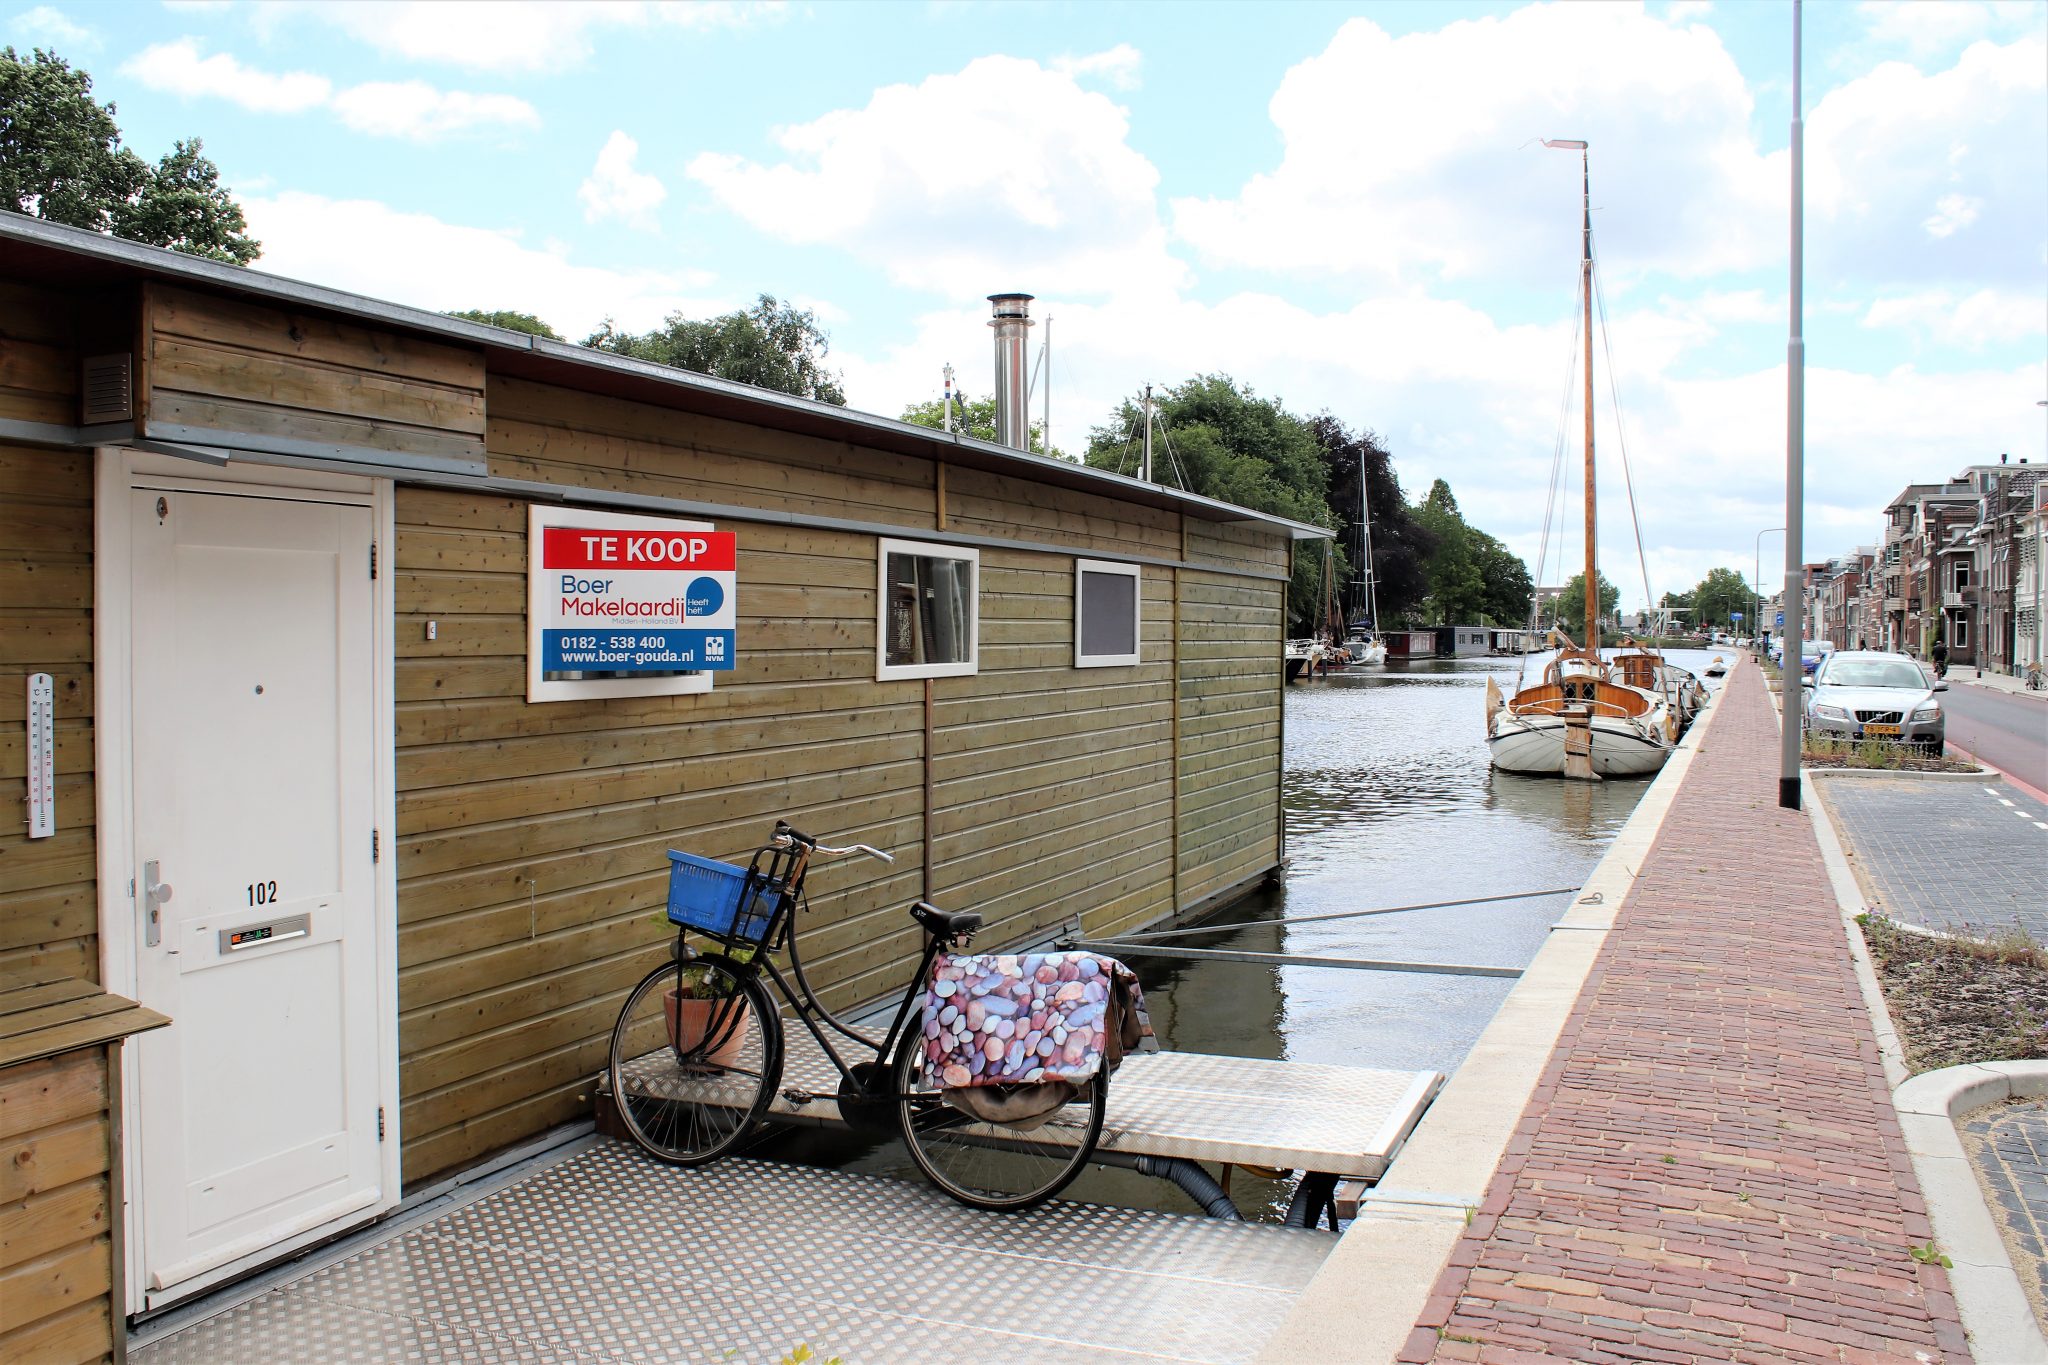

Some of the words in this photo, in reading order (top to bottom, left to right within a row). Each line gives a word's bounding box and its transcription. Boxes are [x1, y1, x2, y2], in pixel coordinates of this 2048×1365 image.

[580, 536, 618, 561] TE
[626, 537, 708, 562] KOOP
[561, 575, 613, 594] Boer
[561, 597, 685, 623] Makelaardij
[687, 598, 709, 606] Heeft
[561, 636, 597, 649] 0182
[610, 637, 636, 649] 538
[639, 637, 666, 649] 400
[561, 650, 694, 664] www.boer-gouda.nl
[247, 880, 277, 906] 102
